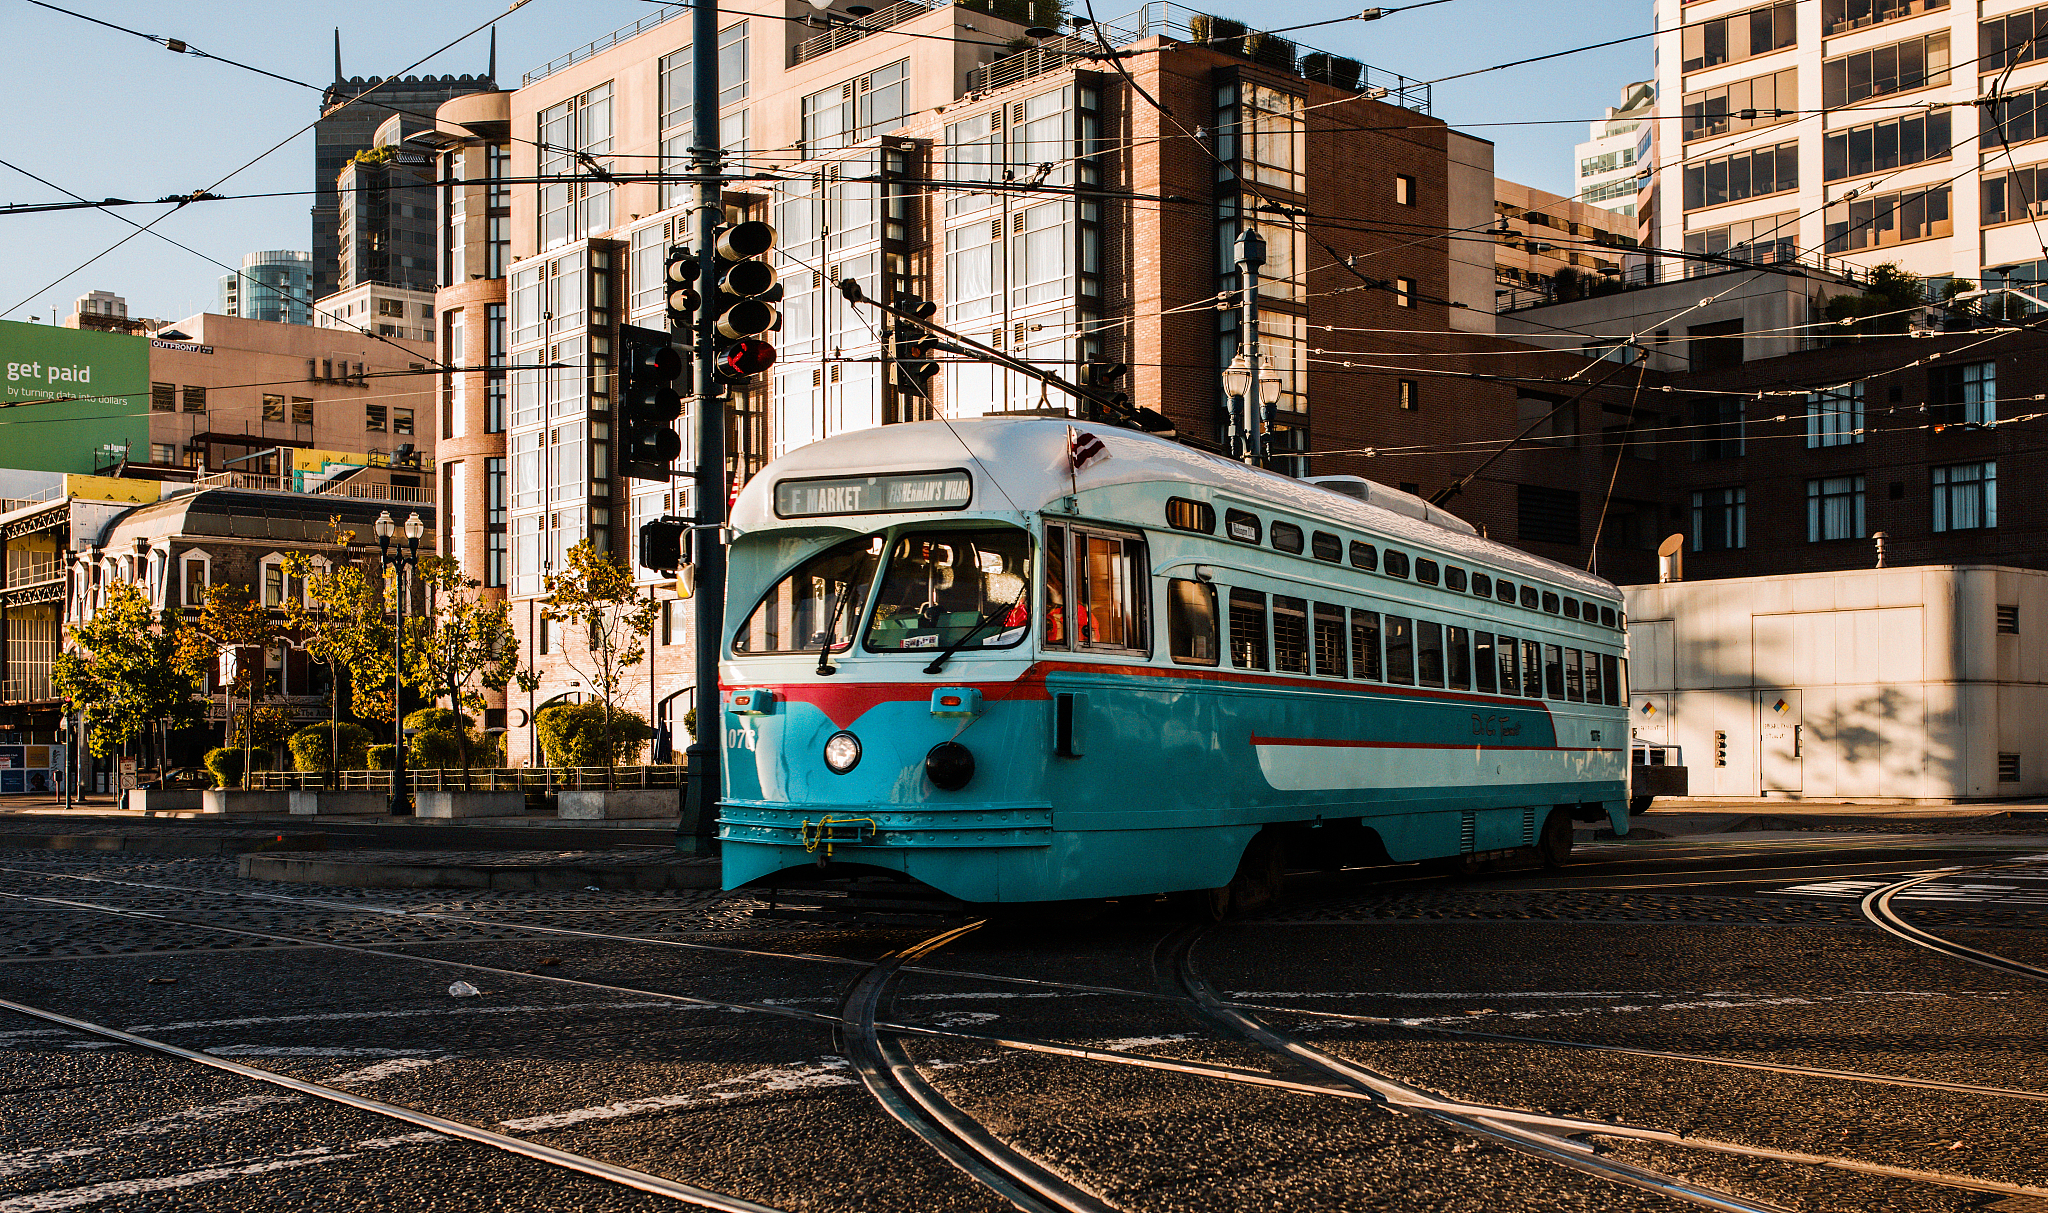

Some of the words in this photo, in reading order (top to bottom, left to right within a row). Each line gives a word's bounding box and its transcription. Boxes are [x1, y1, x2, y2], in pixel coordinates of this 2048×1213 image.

[152, 340, 199, 352] OUTFRONT
[7, 361, 42, 381] get
[48, 364, 91, 384] paid
[7, 385, 19, 397] by
[21, 387, 55, 400] turning
[98, 394, 128, 406] dollars
[791, 489, 801, 513] F
[807, 486, 862, 513] MARKET
[889, 480, 942, 503] FISHERMAN'S
[943, 480, 969, 500] WHAR
